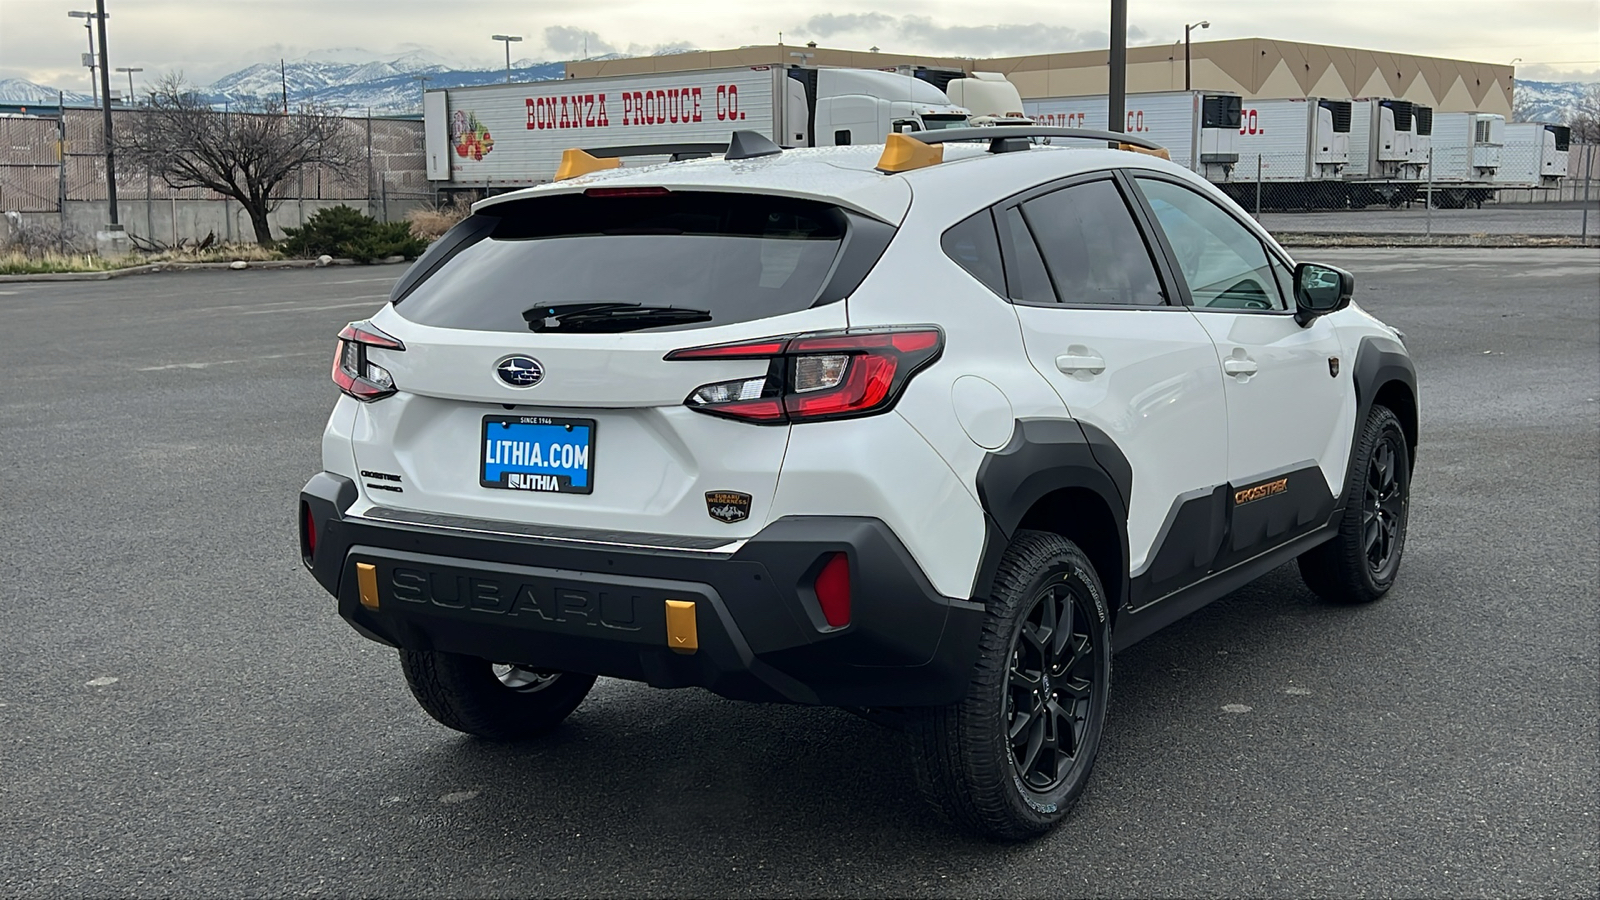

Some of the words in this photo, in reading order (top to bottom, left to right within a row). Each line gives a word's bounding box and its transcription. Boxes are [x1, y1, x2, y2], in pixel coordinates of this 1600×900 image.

[525, 94, 609, 130] BONANZA
[622, 88, 702, 126] PRODUCE
[716, 84, 746, 121] CO.
[1127, 110, 1149, 133] CO.
[486, 439, 589, 470] LITHIA.COM
[520, 474, 560, 491] LITHIA
[1235, 478, 1288, 504] CROSSTREK
[708, 497, 747, 505] WILDERNESS
[392, 567, 642, 631] SUBARU
